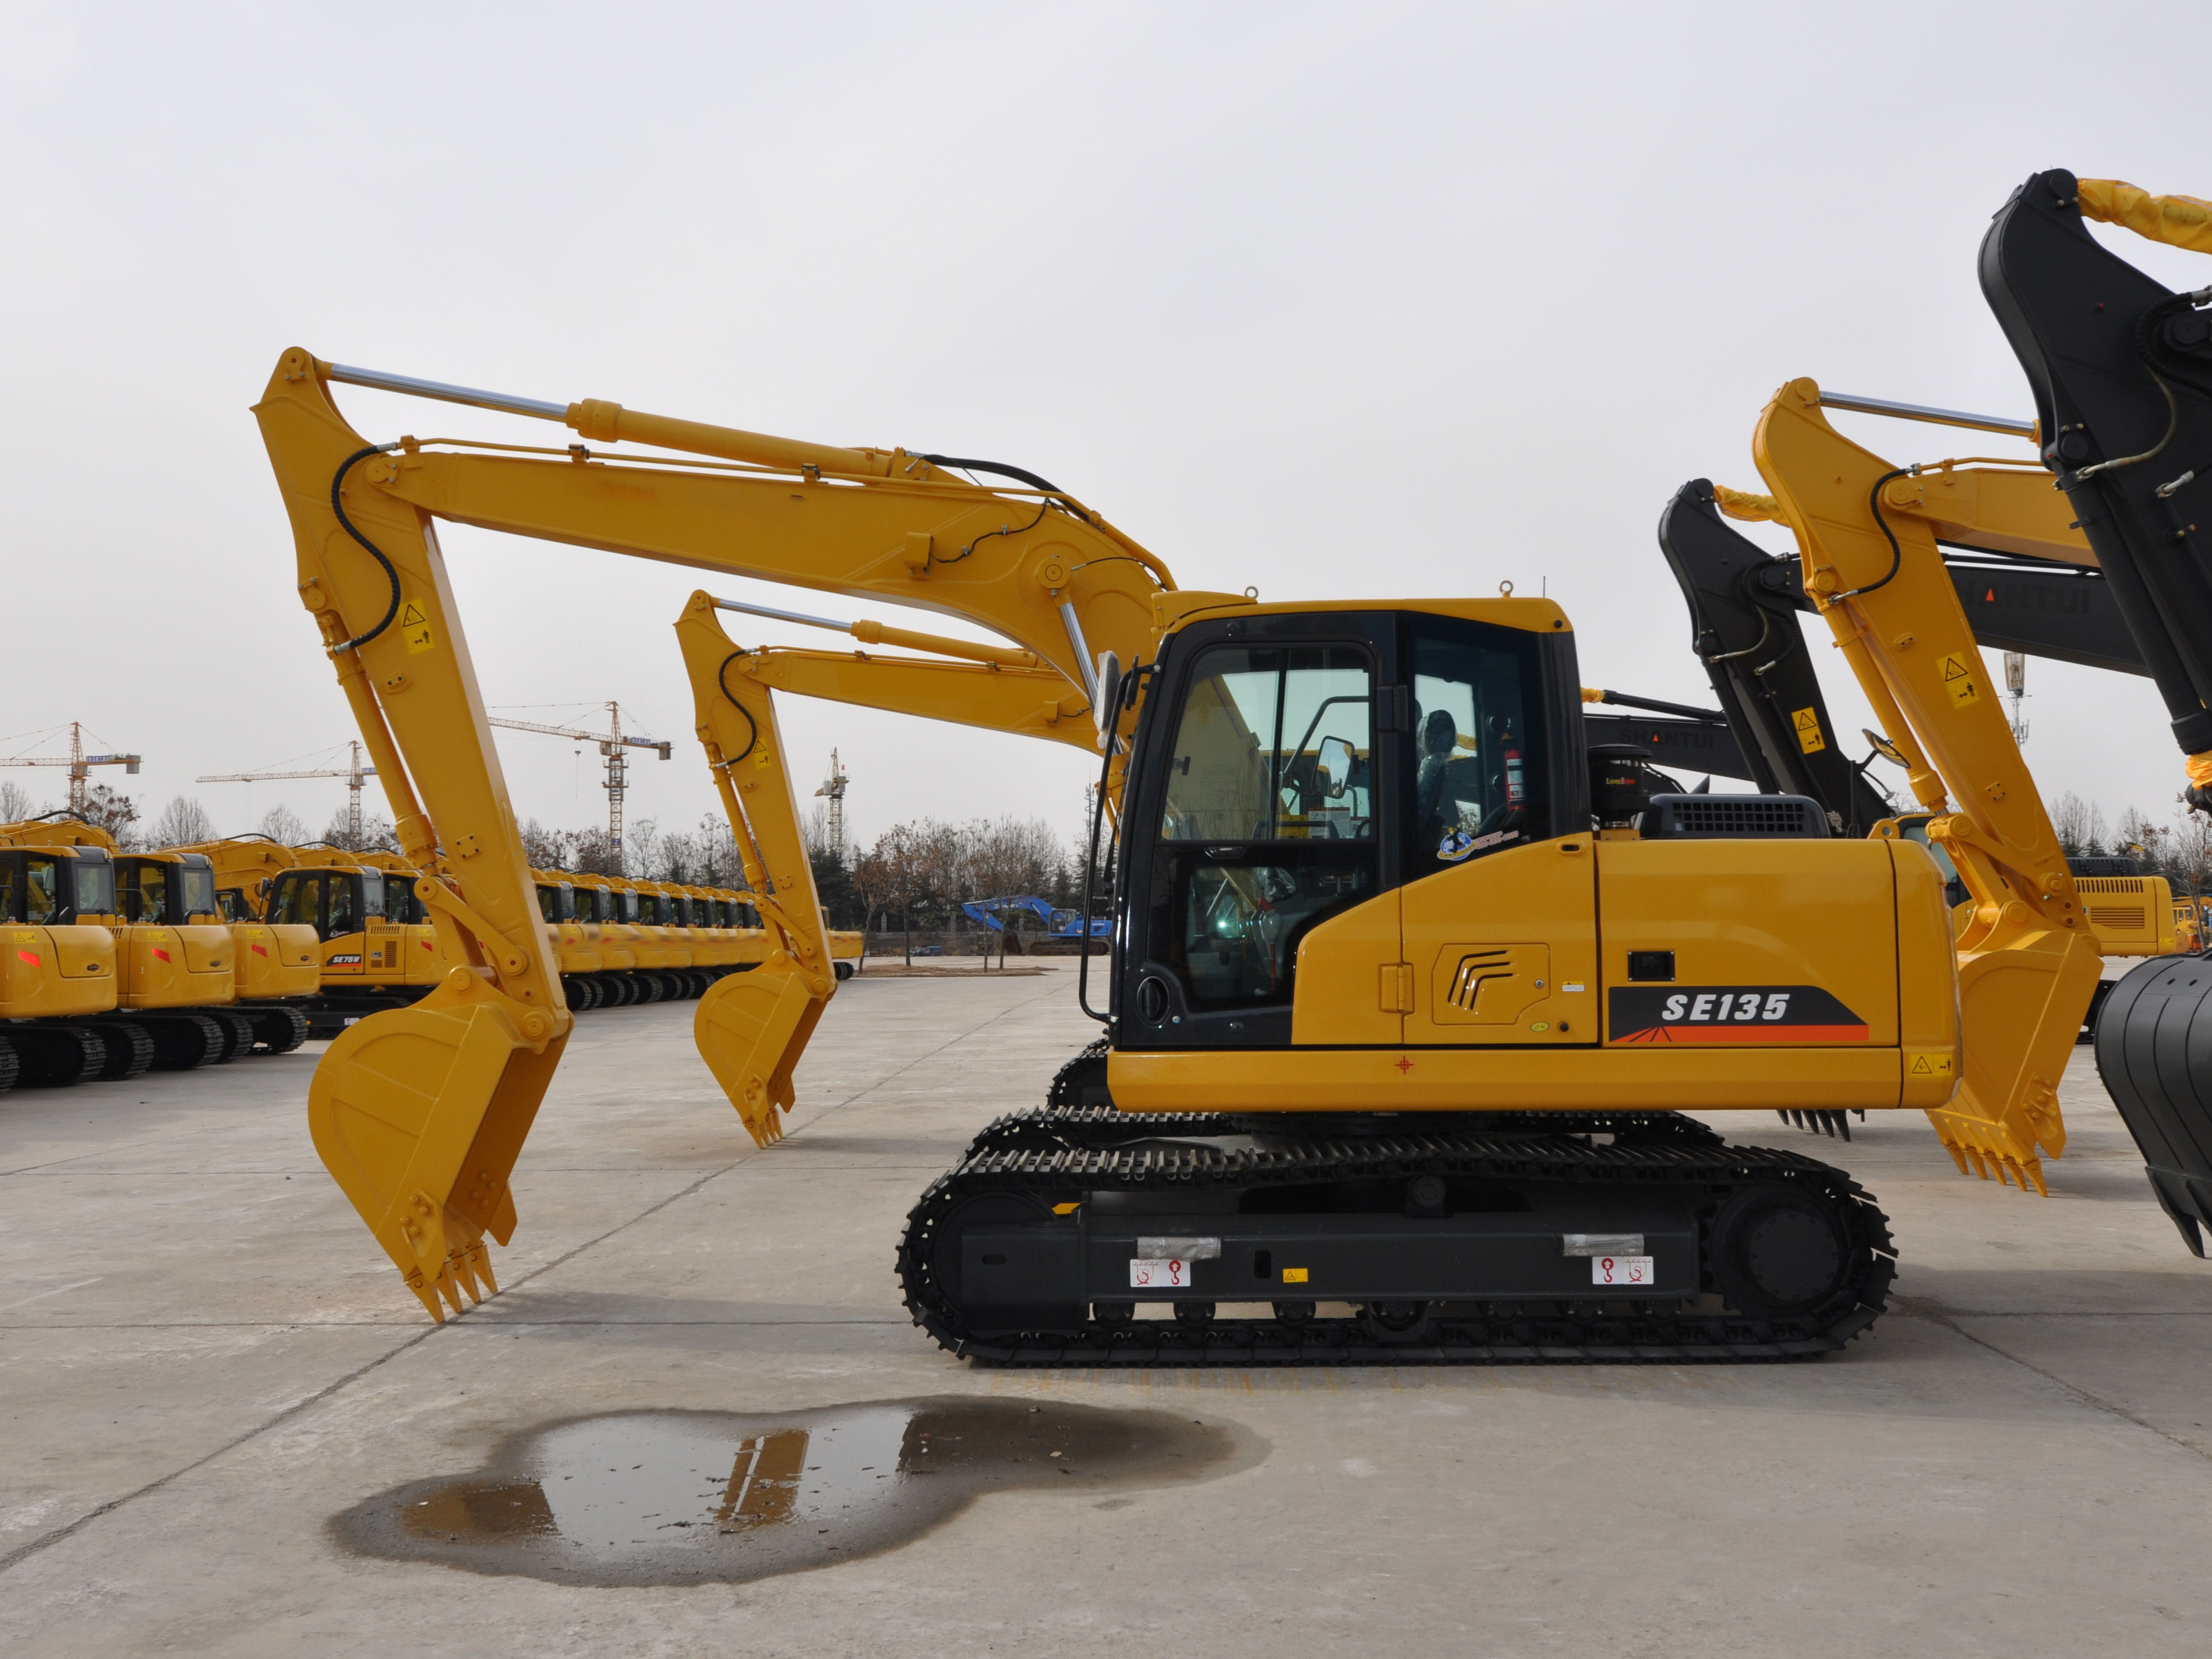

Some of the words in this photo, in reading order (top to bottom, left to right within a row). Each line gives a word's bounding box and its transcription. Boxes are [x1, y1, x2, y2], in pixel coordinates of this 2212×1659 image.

[1955, 579, 2090, 614] HANTUI
[1619, 728, 1713, 749] SHANTUI
[1662, 994, 1790, 1021] SE135
